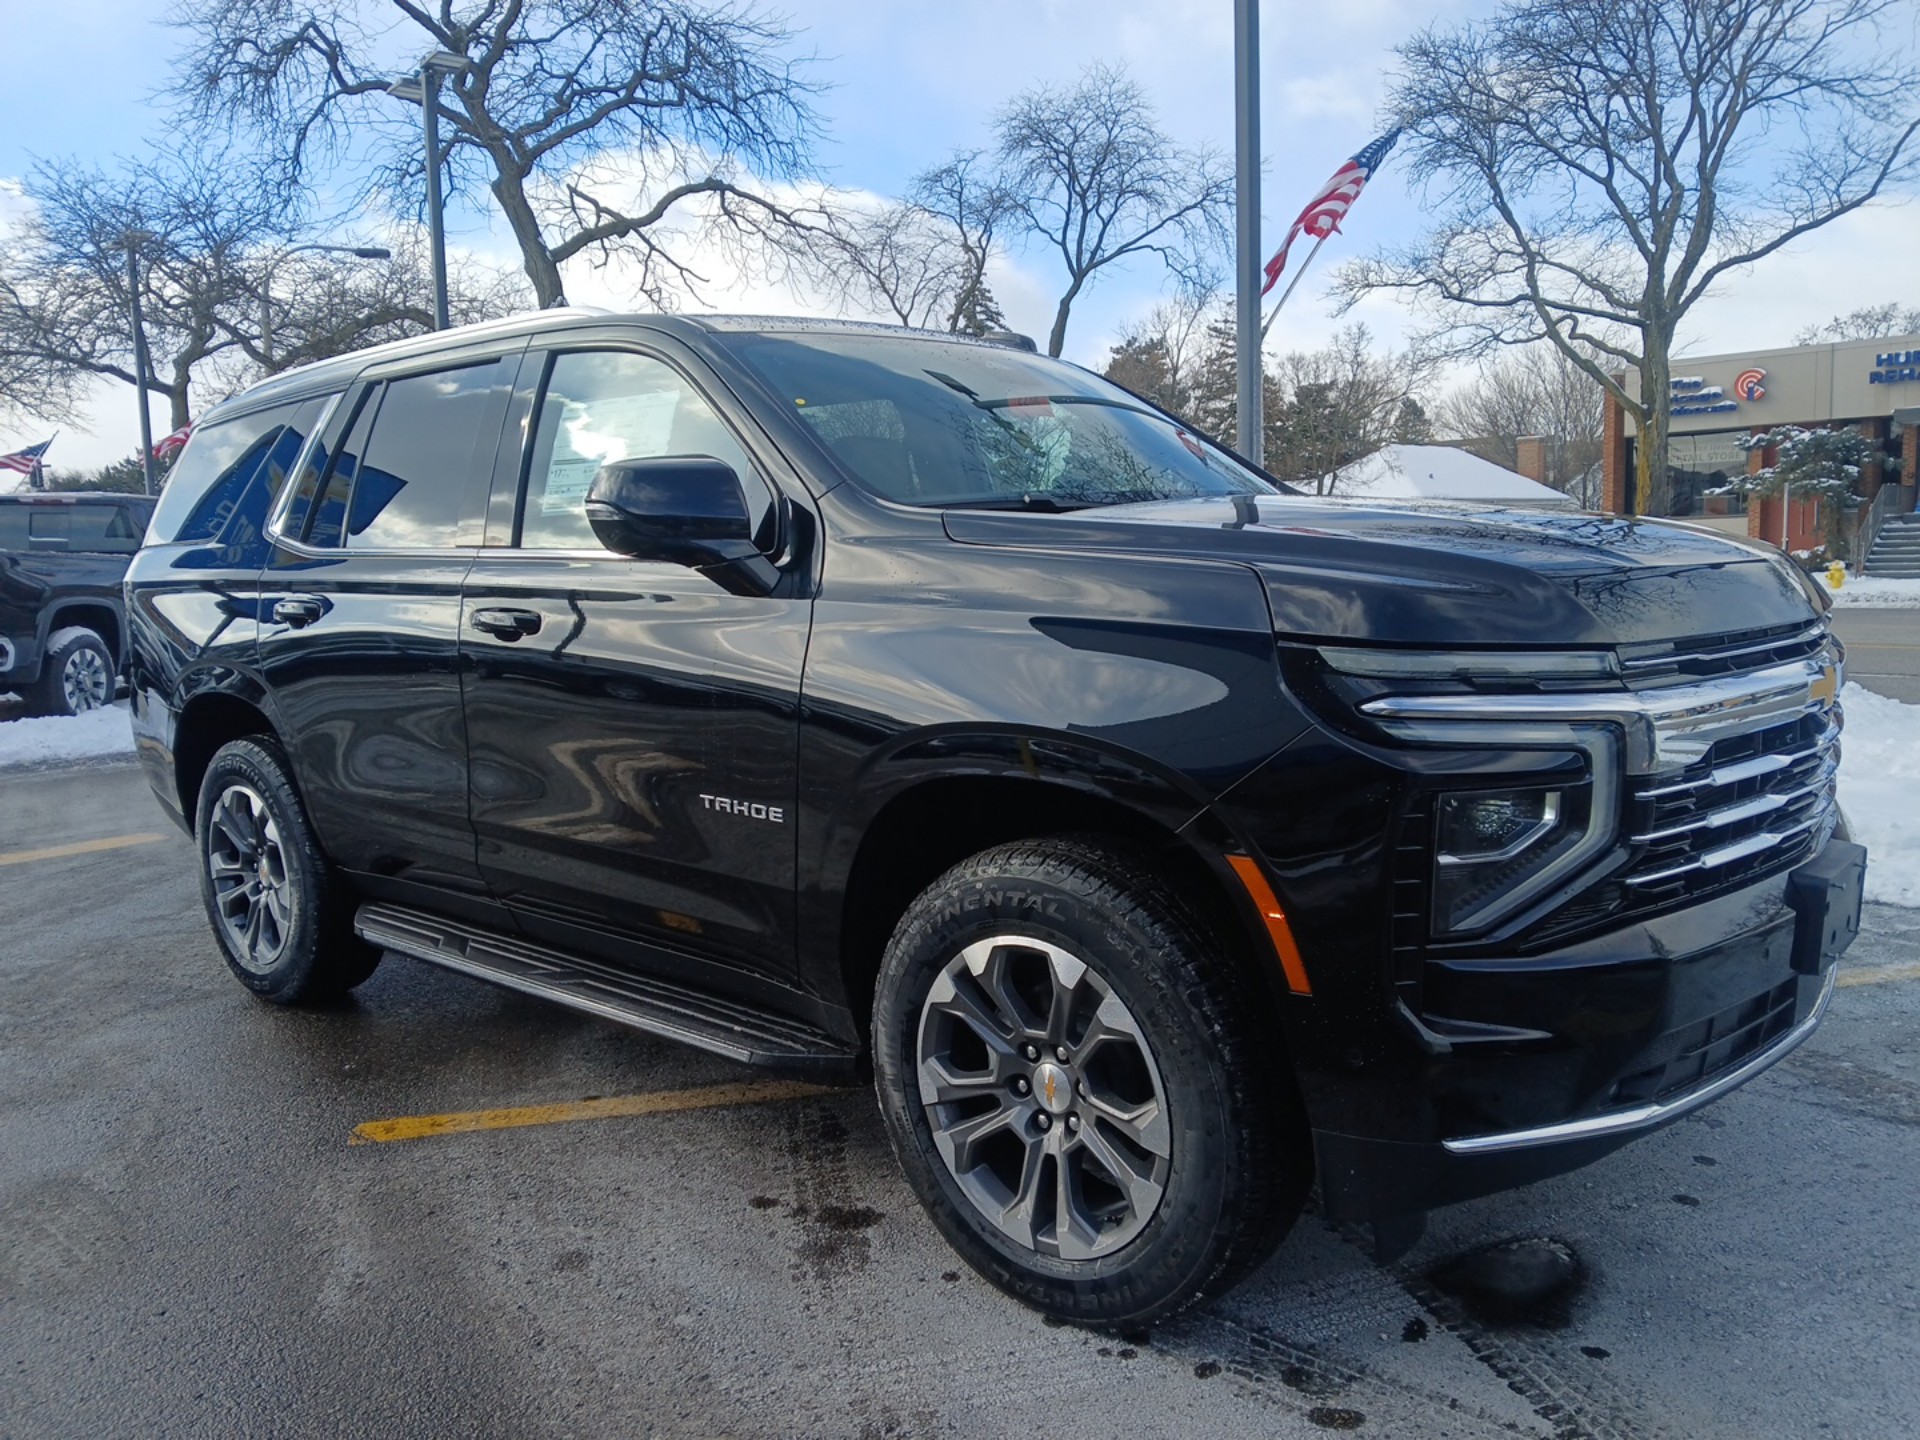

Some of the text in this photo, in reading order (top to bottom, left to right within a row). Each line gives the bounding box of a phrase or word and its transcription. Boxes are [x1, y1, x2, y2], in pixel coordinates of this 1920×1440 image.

[1869, 368, 1920, 384] REH
[1707, 451, 1741, 461] STORE
[699, 794, 784, 823] TAHOE
